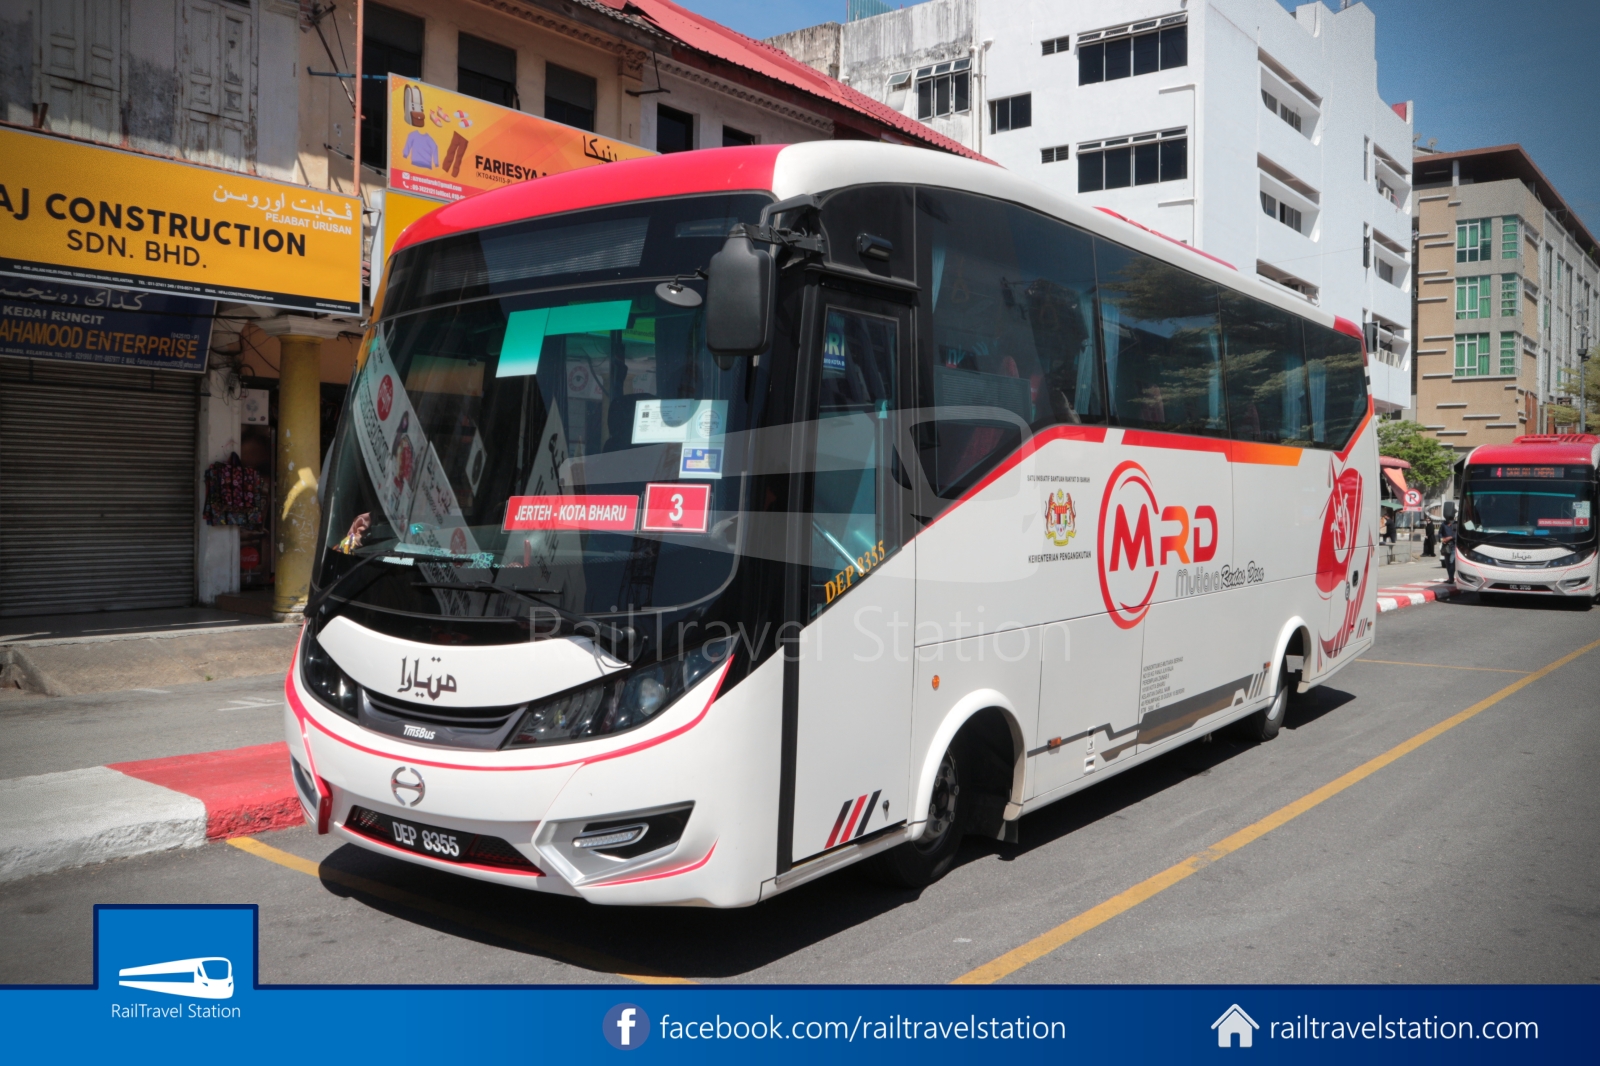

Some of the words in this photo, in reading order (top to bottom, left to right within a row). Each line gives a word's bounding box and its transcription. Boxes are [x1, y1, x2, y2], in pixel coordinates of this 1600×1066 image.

[475, 155, 538, 181] FARIESYA
[45, 193, 305, 257] CONSTRUCTION
[265, 212, 310, 229] PEJABAT
[312, 220, 352, 235] URUSAN
[67, 229, 134, 258] SDN.
[145, 240, 207, 269] BHD.
[2, 305, 47, 319] KEDAI
[51, 311, 104, 325] RUNCIT
[86, 329, 198, 359] ENTERPRISE
[514, 504, 552, 521] JERTEH
[558, 504, 586, 521] KOTA
[588, 505, 627, 522] BHARU
[669, 493, 684, 522] 3
[1109, 503, 1219, 572] MRD
[1028, 552, 1059, 563] KEMENTERIAN
[1059, 550, 1092, 561] PENGANGKUTAN
[823, 563, 855, 605] DEP
[858, 540, 887, 578] 8355
[1175, 566, 1220, 597] Mutiara
[403, 724, 436, 740] TmsBus
[392, 820, 417, 846] DEP
[421, 830, 460, 857] 8355
